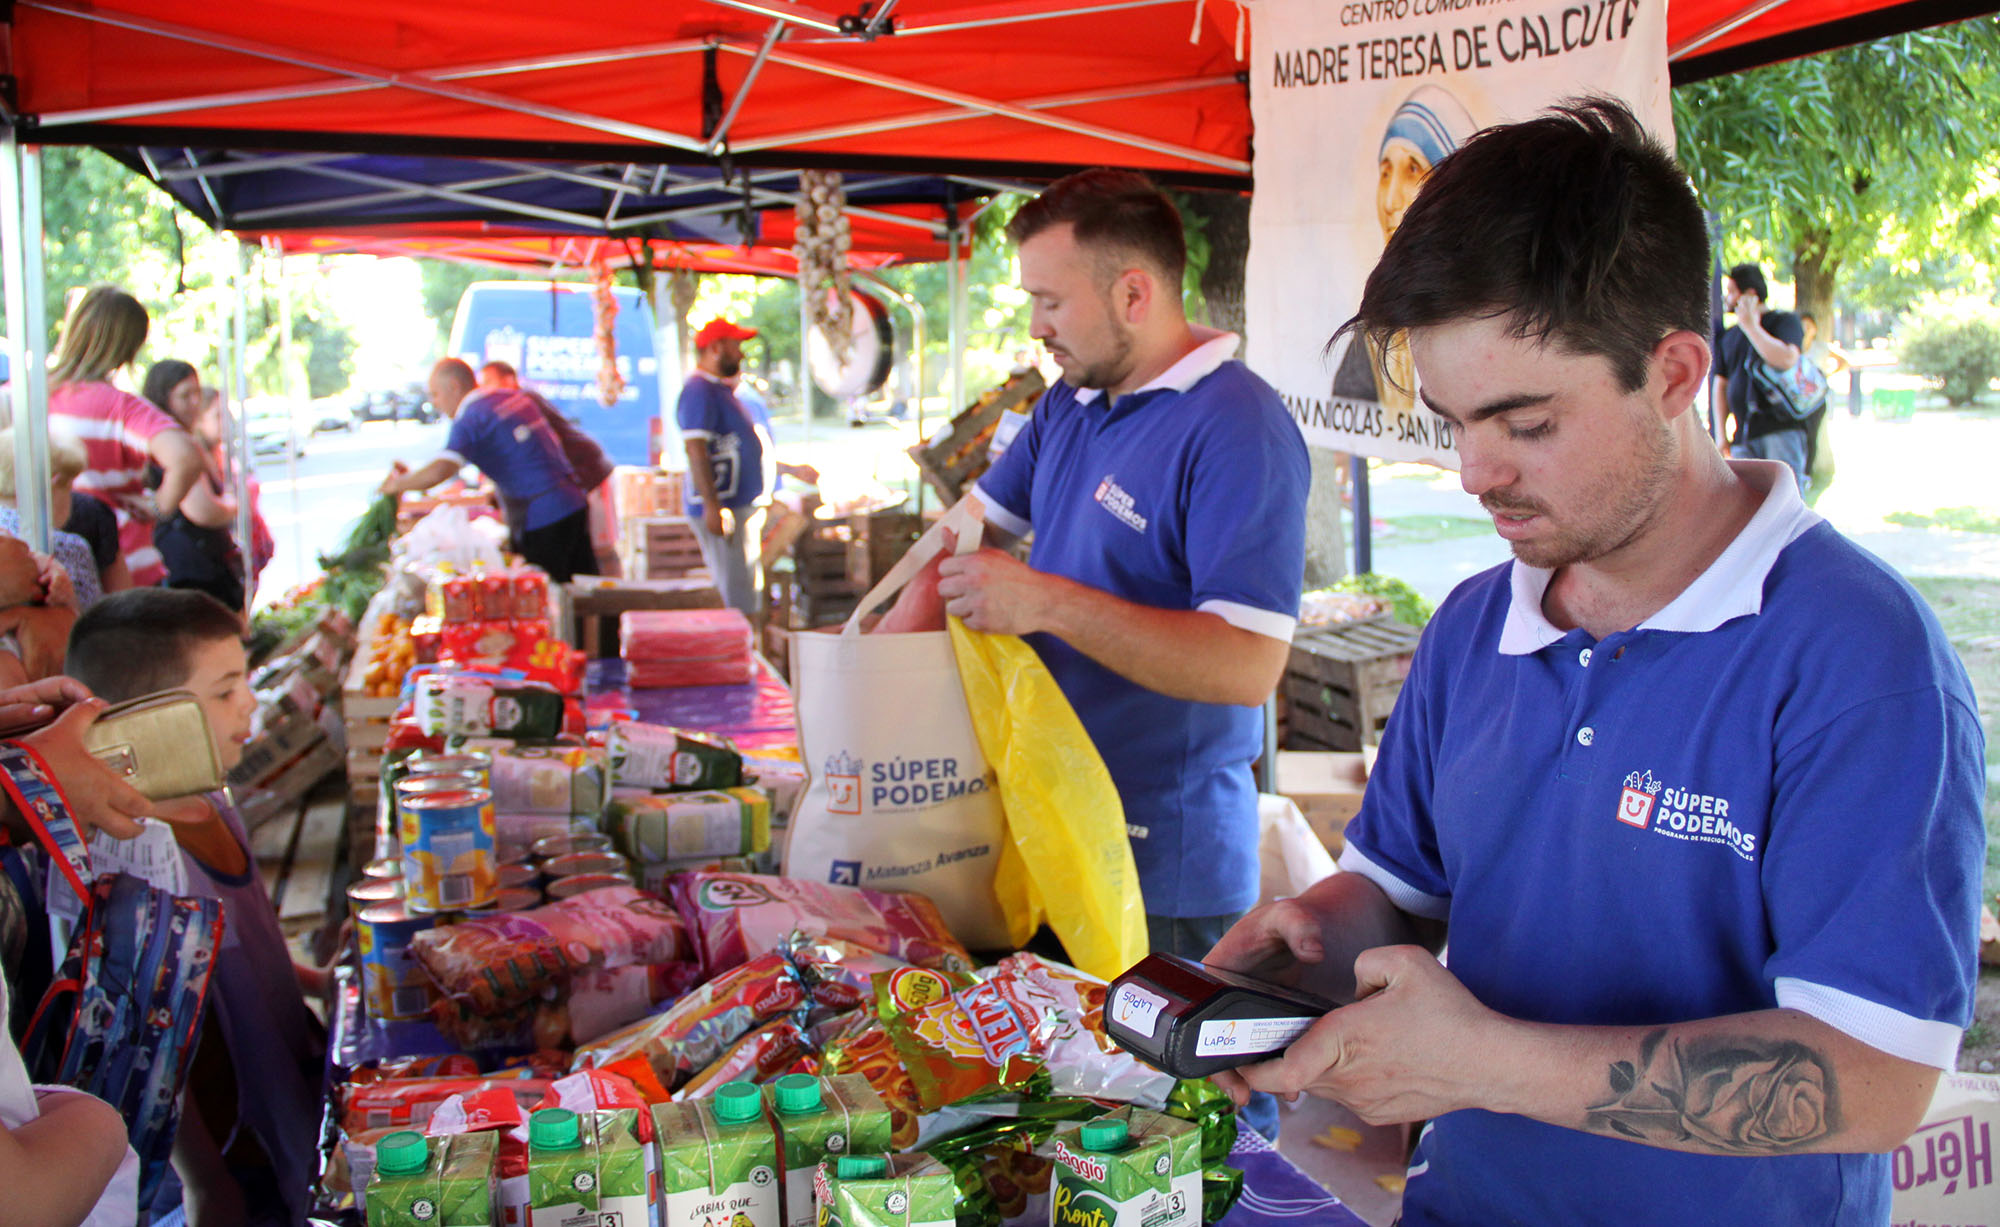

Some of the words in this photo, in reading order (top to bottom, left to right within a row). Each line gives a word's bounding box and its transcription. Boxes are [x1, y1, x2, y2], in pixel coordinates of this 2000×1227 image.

[1340, 0, 1408, 27] CENTRO
[1273, 44, 1350, 88] MADRE
[1356, 32, 1447, 81] TERESA
[1453, 25, 1492, 71] DE
[1275, 389, 1311, 425] AN
[1313, 398, 1384, 438] NICOLAS
[1397, 411, 1430, 447] SAN
[871, 755, 958, 783] SÚPER
[1661, 786, 1729, 817] SÚPER
[1653, 826, 1690, 841] PROGRAMA
[1699, 836, 1726, 845] PRECIOS
[1656, 806, 1756, 852] PODEMOS
[866, 860, 932, 881] Matanza
[935, 844, 990, 868] Avanza
[1055, 1142, 1105, 1182] Baggio
[1171, 1195, 1181, 1210] 3
[605, 1215, 616, 1227] 3
